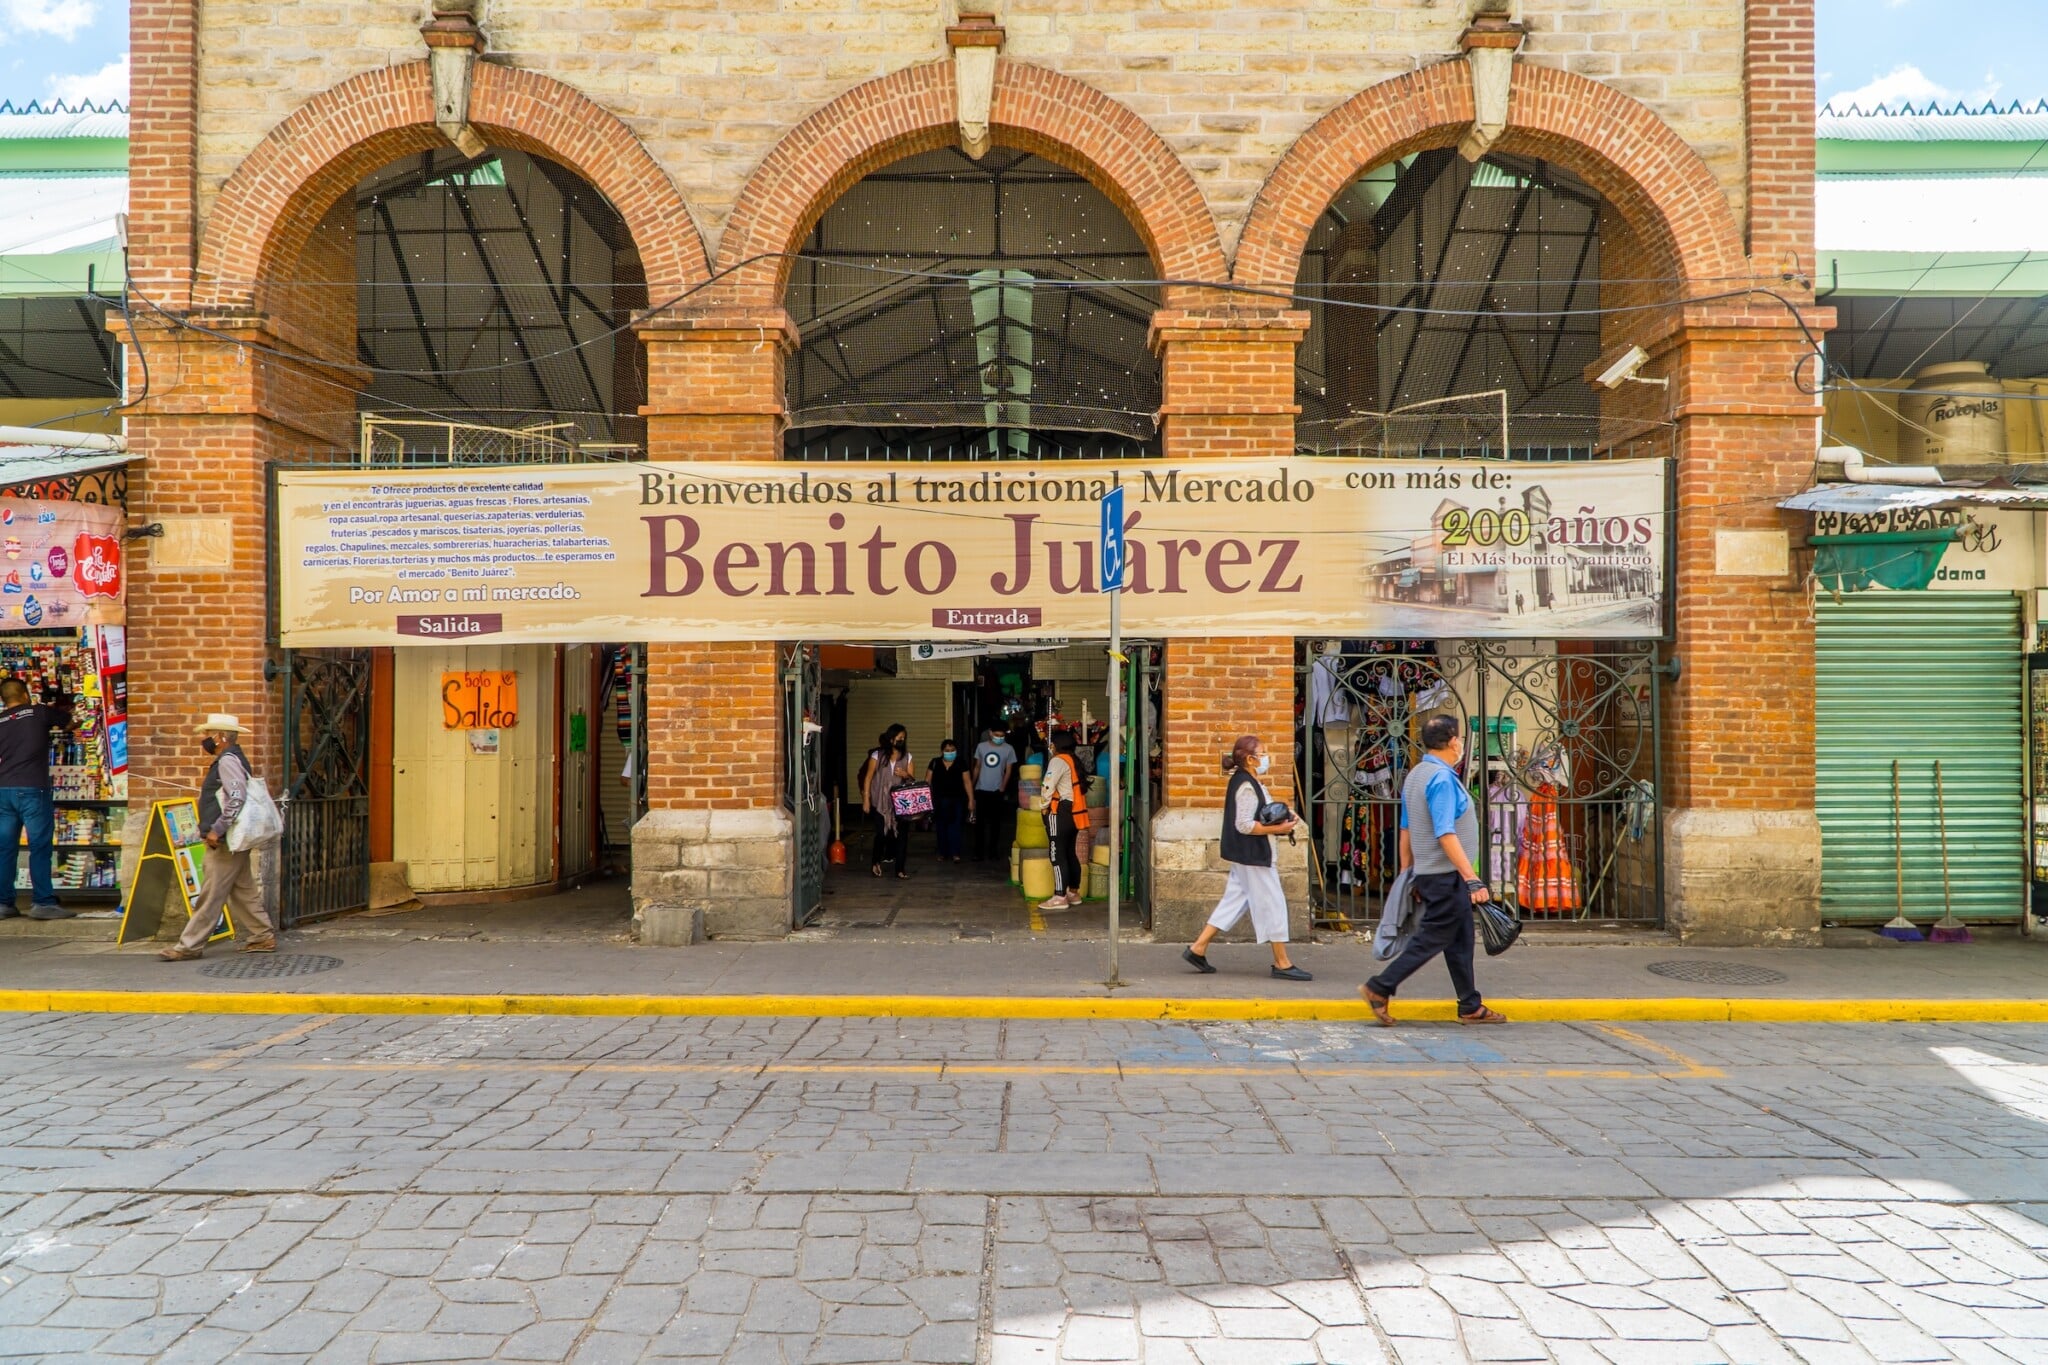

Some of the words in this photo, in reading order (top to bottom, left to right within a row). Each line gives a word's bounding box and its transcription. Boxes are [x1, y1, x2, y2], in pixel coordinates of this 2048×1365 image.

[1935, 399, 1998, 422] Rotoplas
[638, 472, 852, 506] Bienvendos
[867, 472, 900, 503] al
[1140, 467, 1315, 504] Mercado
[1345, 471, 1395, 490] con
[1406, 466, 1461, 490] más
[1472, 466, 1512, 490] de:
[371, 486, 380, 494] Te
[383, 486, 411, 494] Ofrece
[413, 485, 455, 495] productos
[458, 485, 468, 493] de
[471, 483, 511, 492] excelente
[513, 482, 543, 491] calidad
[324, 503, 328, 511] y
[343, 501, 351, 509] el
[448, 500, 473, 509] aguas
[476, 498, 506, 506] frescas
[329, 516, 348, 525] ropa
[1441, 508, 1532, 547] 200
[1547, 505, 1653, 546] años
[413, 530, 418, 538] y
[430, 558, 435, 566] y
[437, 554, 470, 564] muchos
[473, 552, 490, 562] más
[556, 552, 602, 563] esperamos
[640, 512, 957, 598] Benito
[990, 510, 1304, 596] Juárez
[1447, 552, 1464, 566] El
[1471, 551, 1506, 566] Más
[1512, 552, 1567, 566] bonito
[1573, 556, 1582, 569] y
[1587, 553, 1653, 570] antiguo
[399, 570, 407, 579] el
[408, 568, 445, 578] mercado
[350, 586, 383, 604] Por
[387, 585, 441, 603] Amor
[445, 590, 459, 602] a
[463, 584, 487, 601] mi
[492, 582, 581, 601] mercado.
[419, 616, 481, 634] Salida
[946, 608, 1030, 626] Entrada
